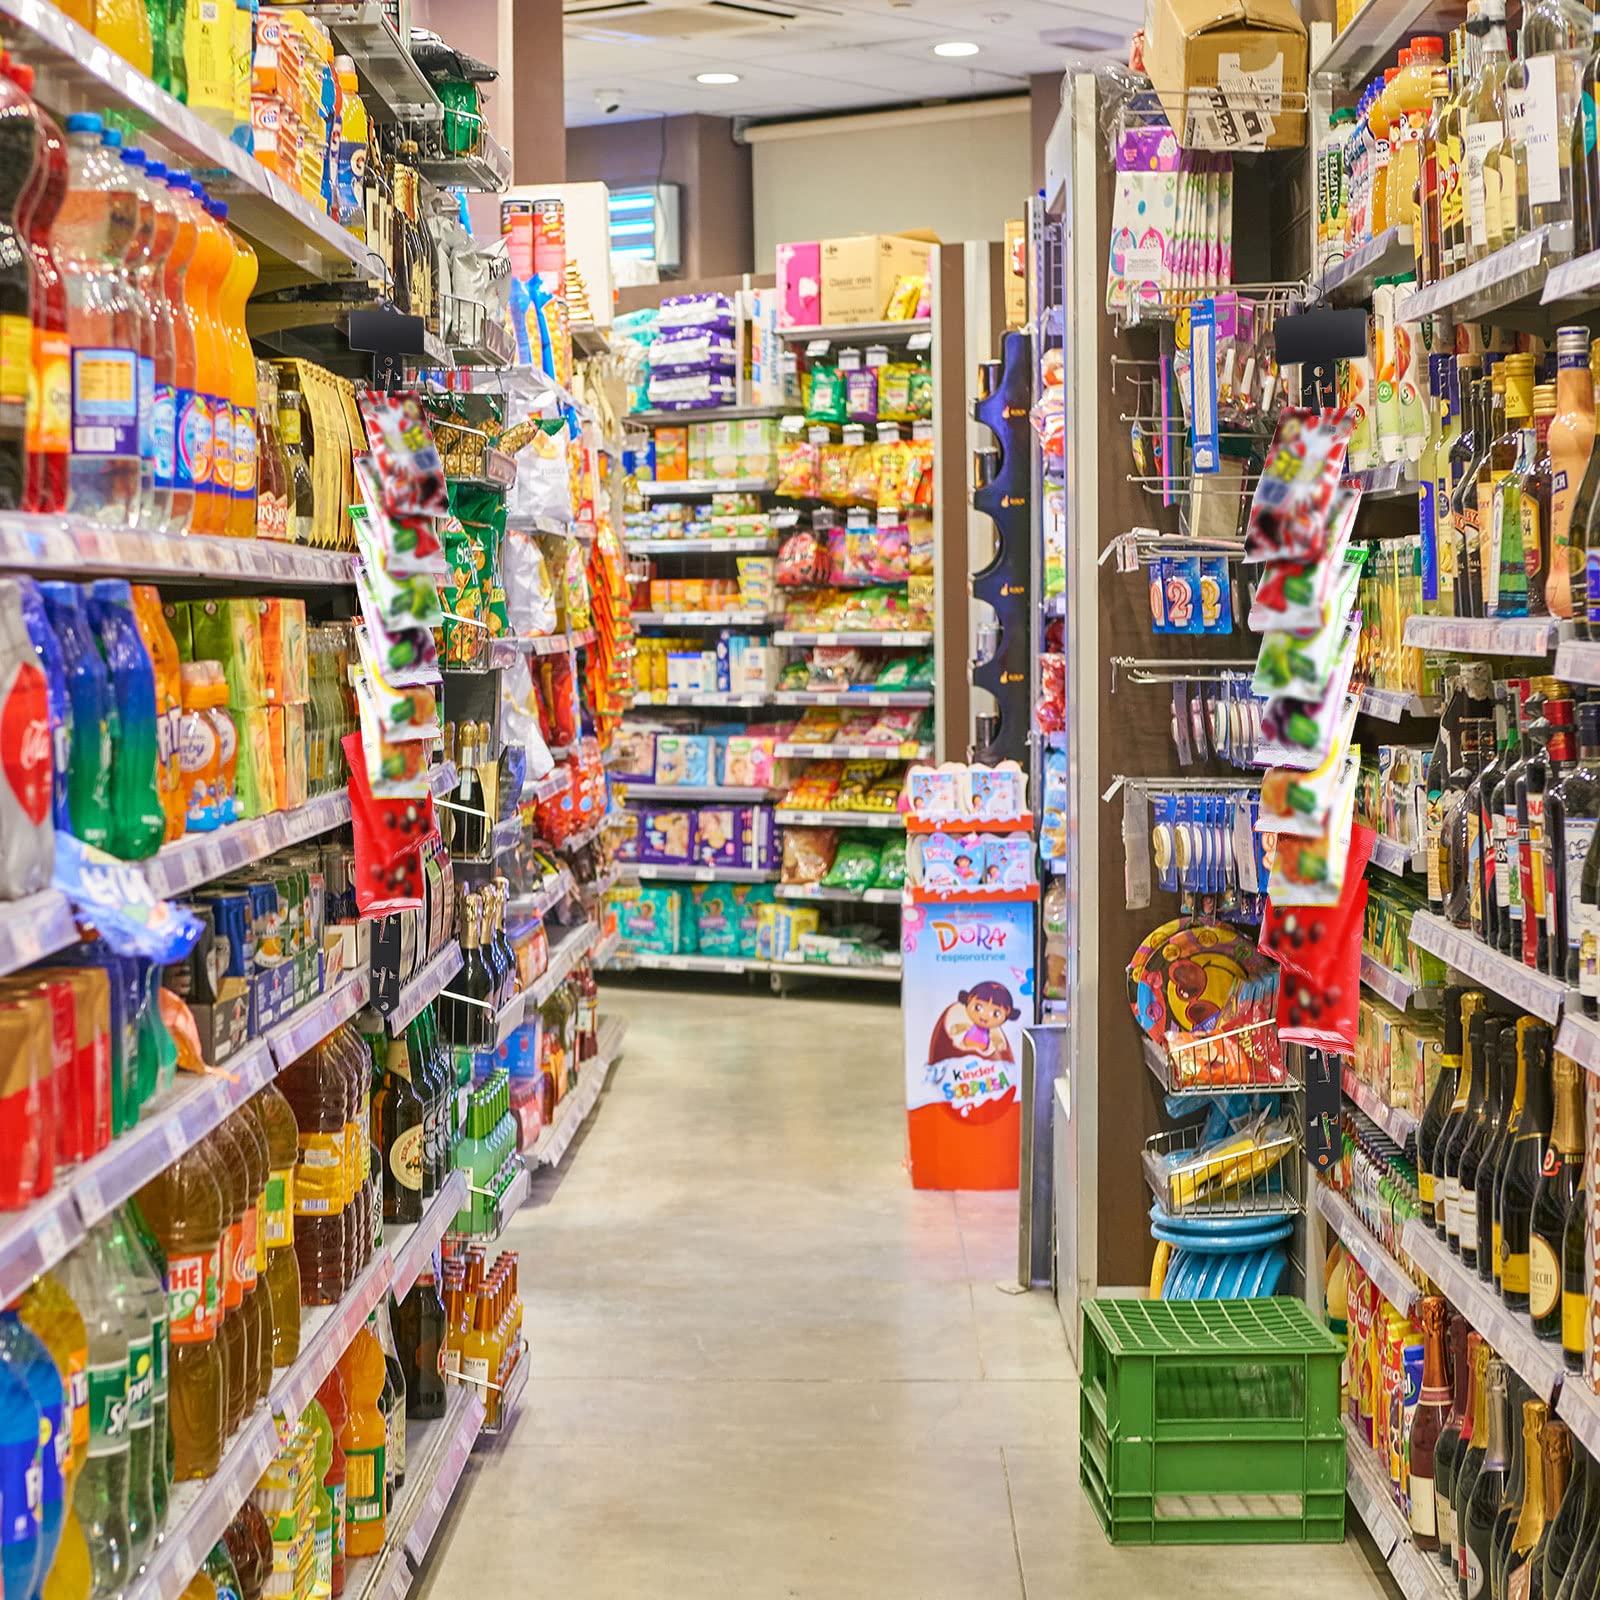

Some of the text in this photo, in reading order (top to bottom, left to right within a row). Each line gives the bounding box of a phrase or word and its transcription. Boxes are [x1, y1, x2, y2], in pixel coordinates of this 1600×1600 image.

[1319, 159, 1328, 214] SKIPPER
[1329, 153, 1339, 207] SKIPPER
[931, 921, 1006, 953] DORA
[942, 1071, 1010, 1100] SORPRESA
[952, 1064, 995, 1081] Kinder
